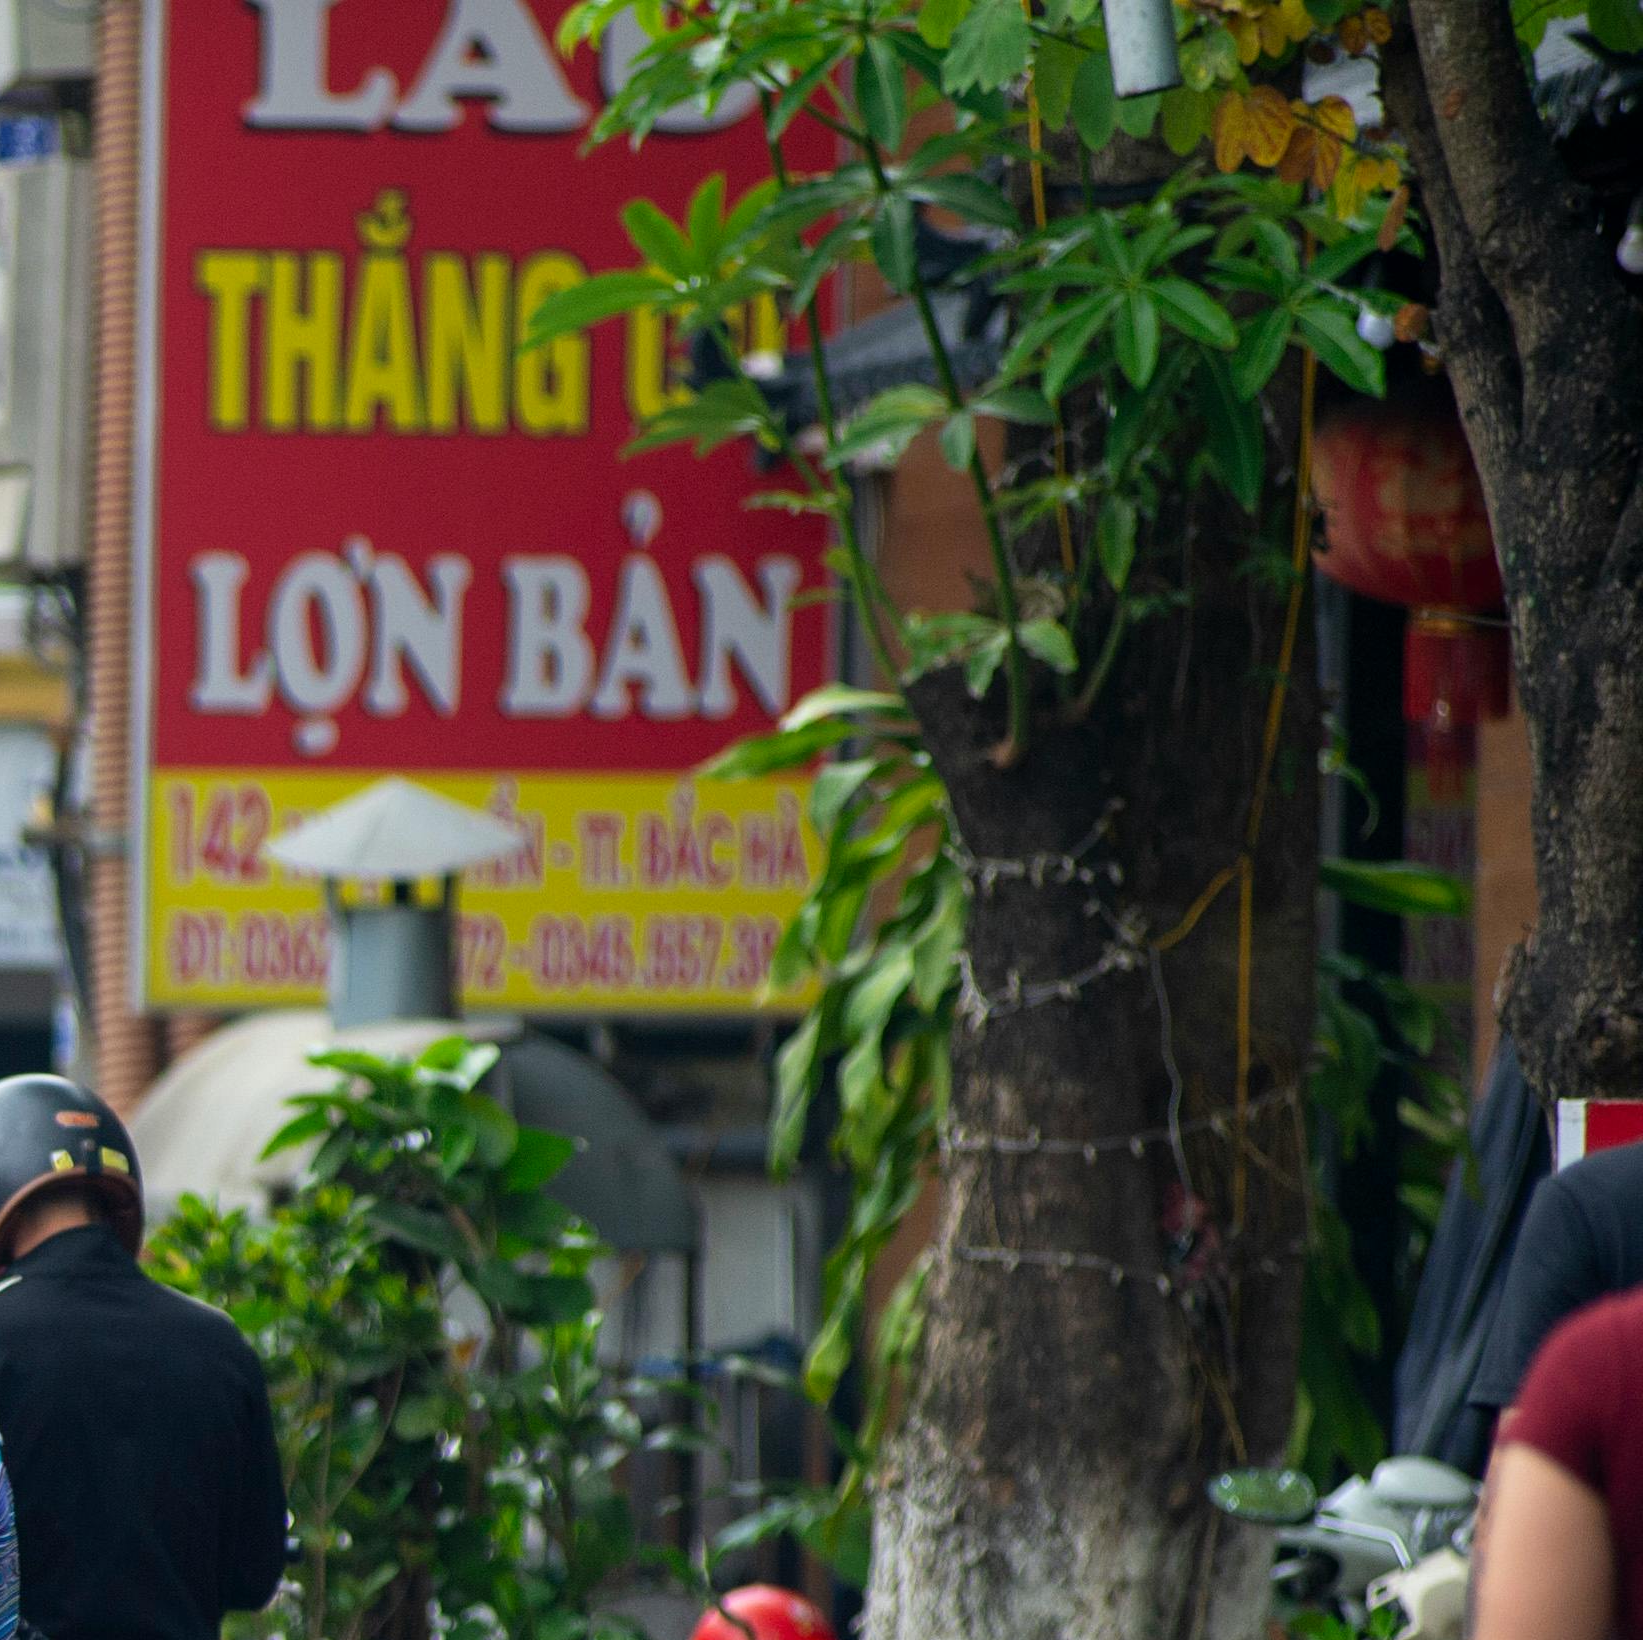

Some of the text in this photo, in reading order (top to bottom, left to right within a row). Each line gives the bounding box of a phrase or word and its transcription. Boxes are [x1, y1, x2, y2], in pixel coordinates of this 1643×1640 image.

[189, 491, 803, 757] LỢN BẢN
[170, 782, 272, 888] 142
[737, 785, 811, 892] HÀ
